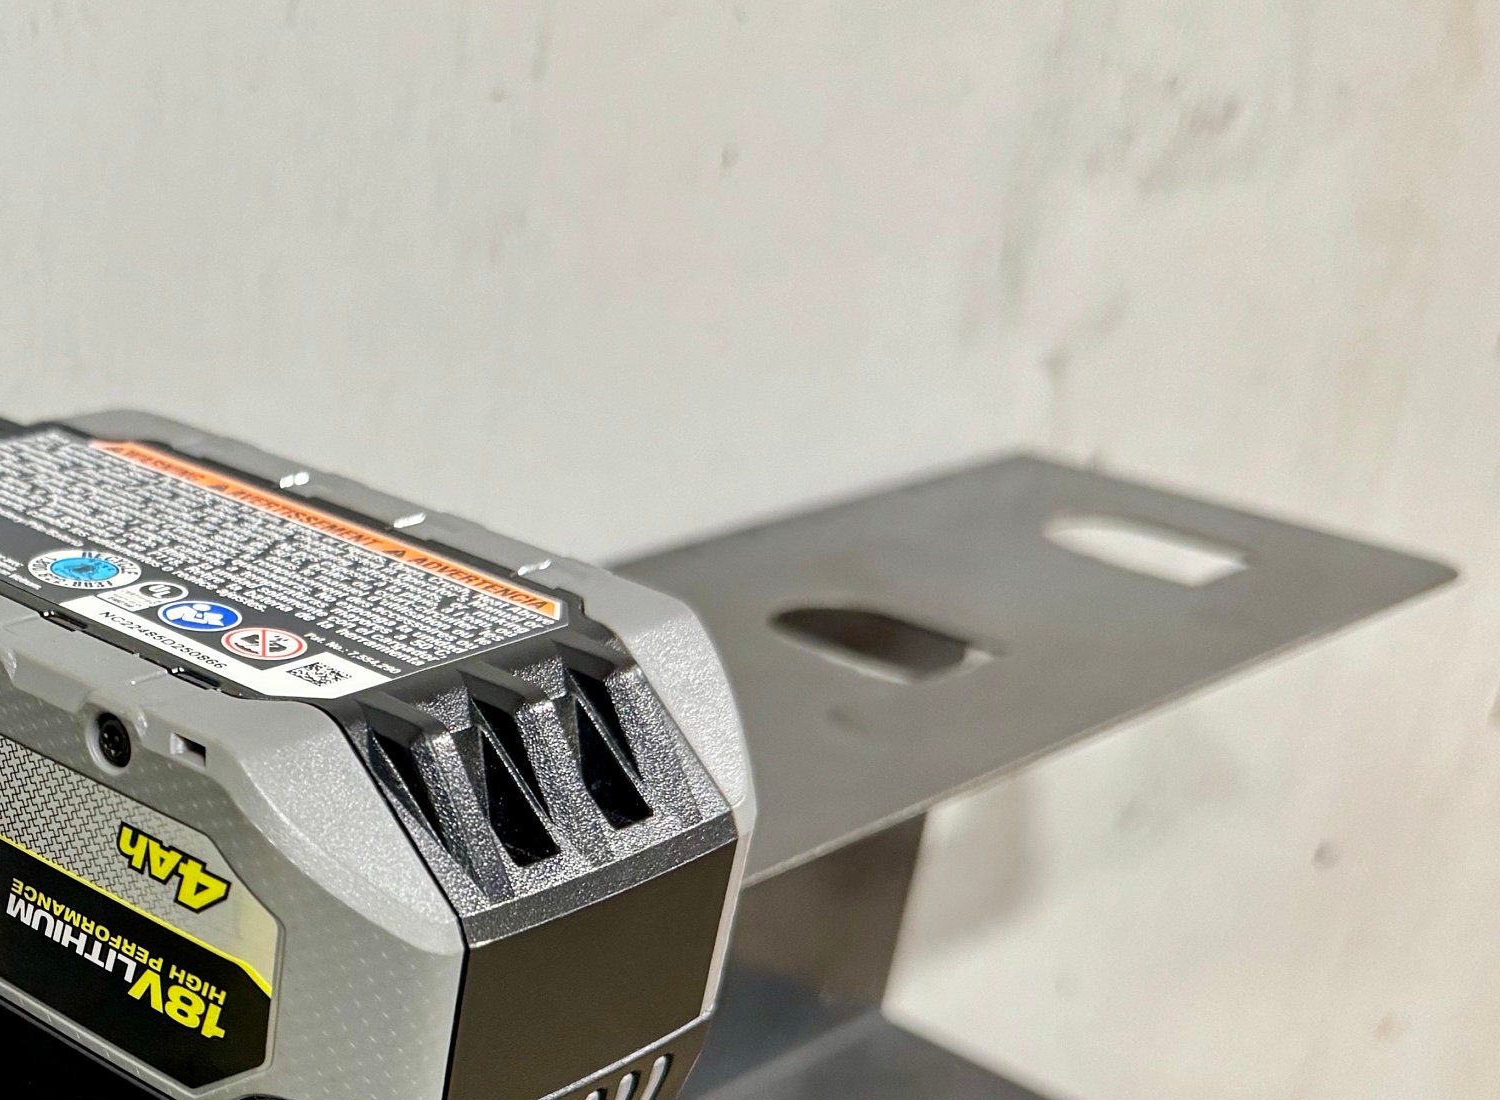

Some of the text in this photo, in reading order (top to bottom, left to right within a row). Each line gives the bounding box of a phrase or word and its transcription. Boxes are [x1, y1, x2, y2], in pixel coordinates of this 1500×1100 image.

[408, 557, 548, 609] ADVERTENCIA
[116, 821, 232, 914] 4Ah
[6, 892, 226, 1039] 18V LITHIUM
[10, 877, 227, 1005] HIGH PERFORMANCE
